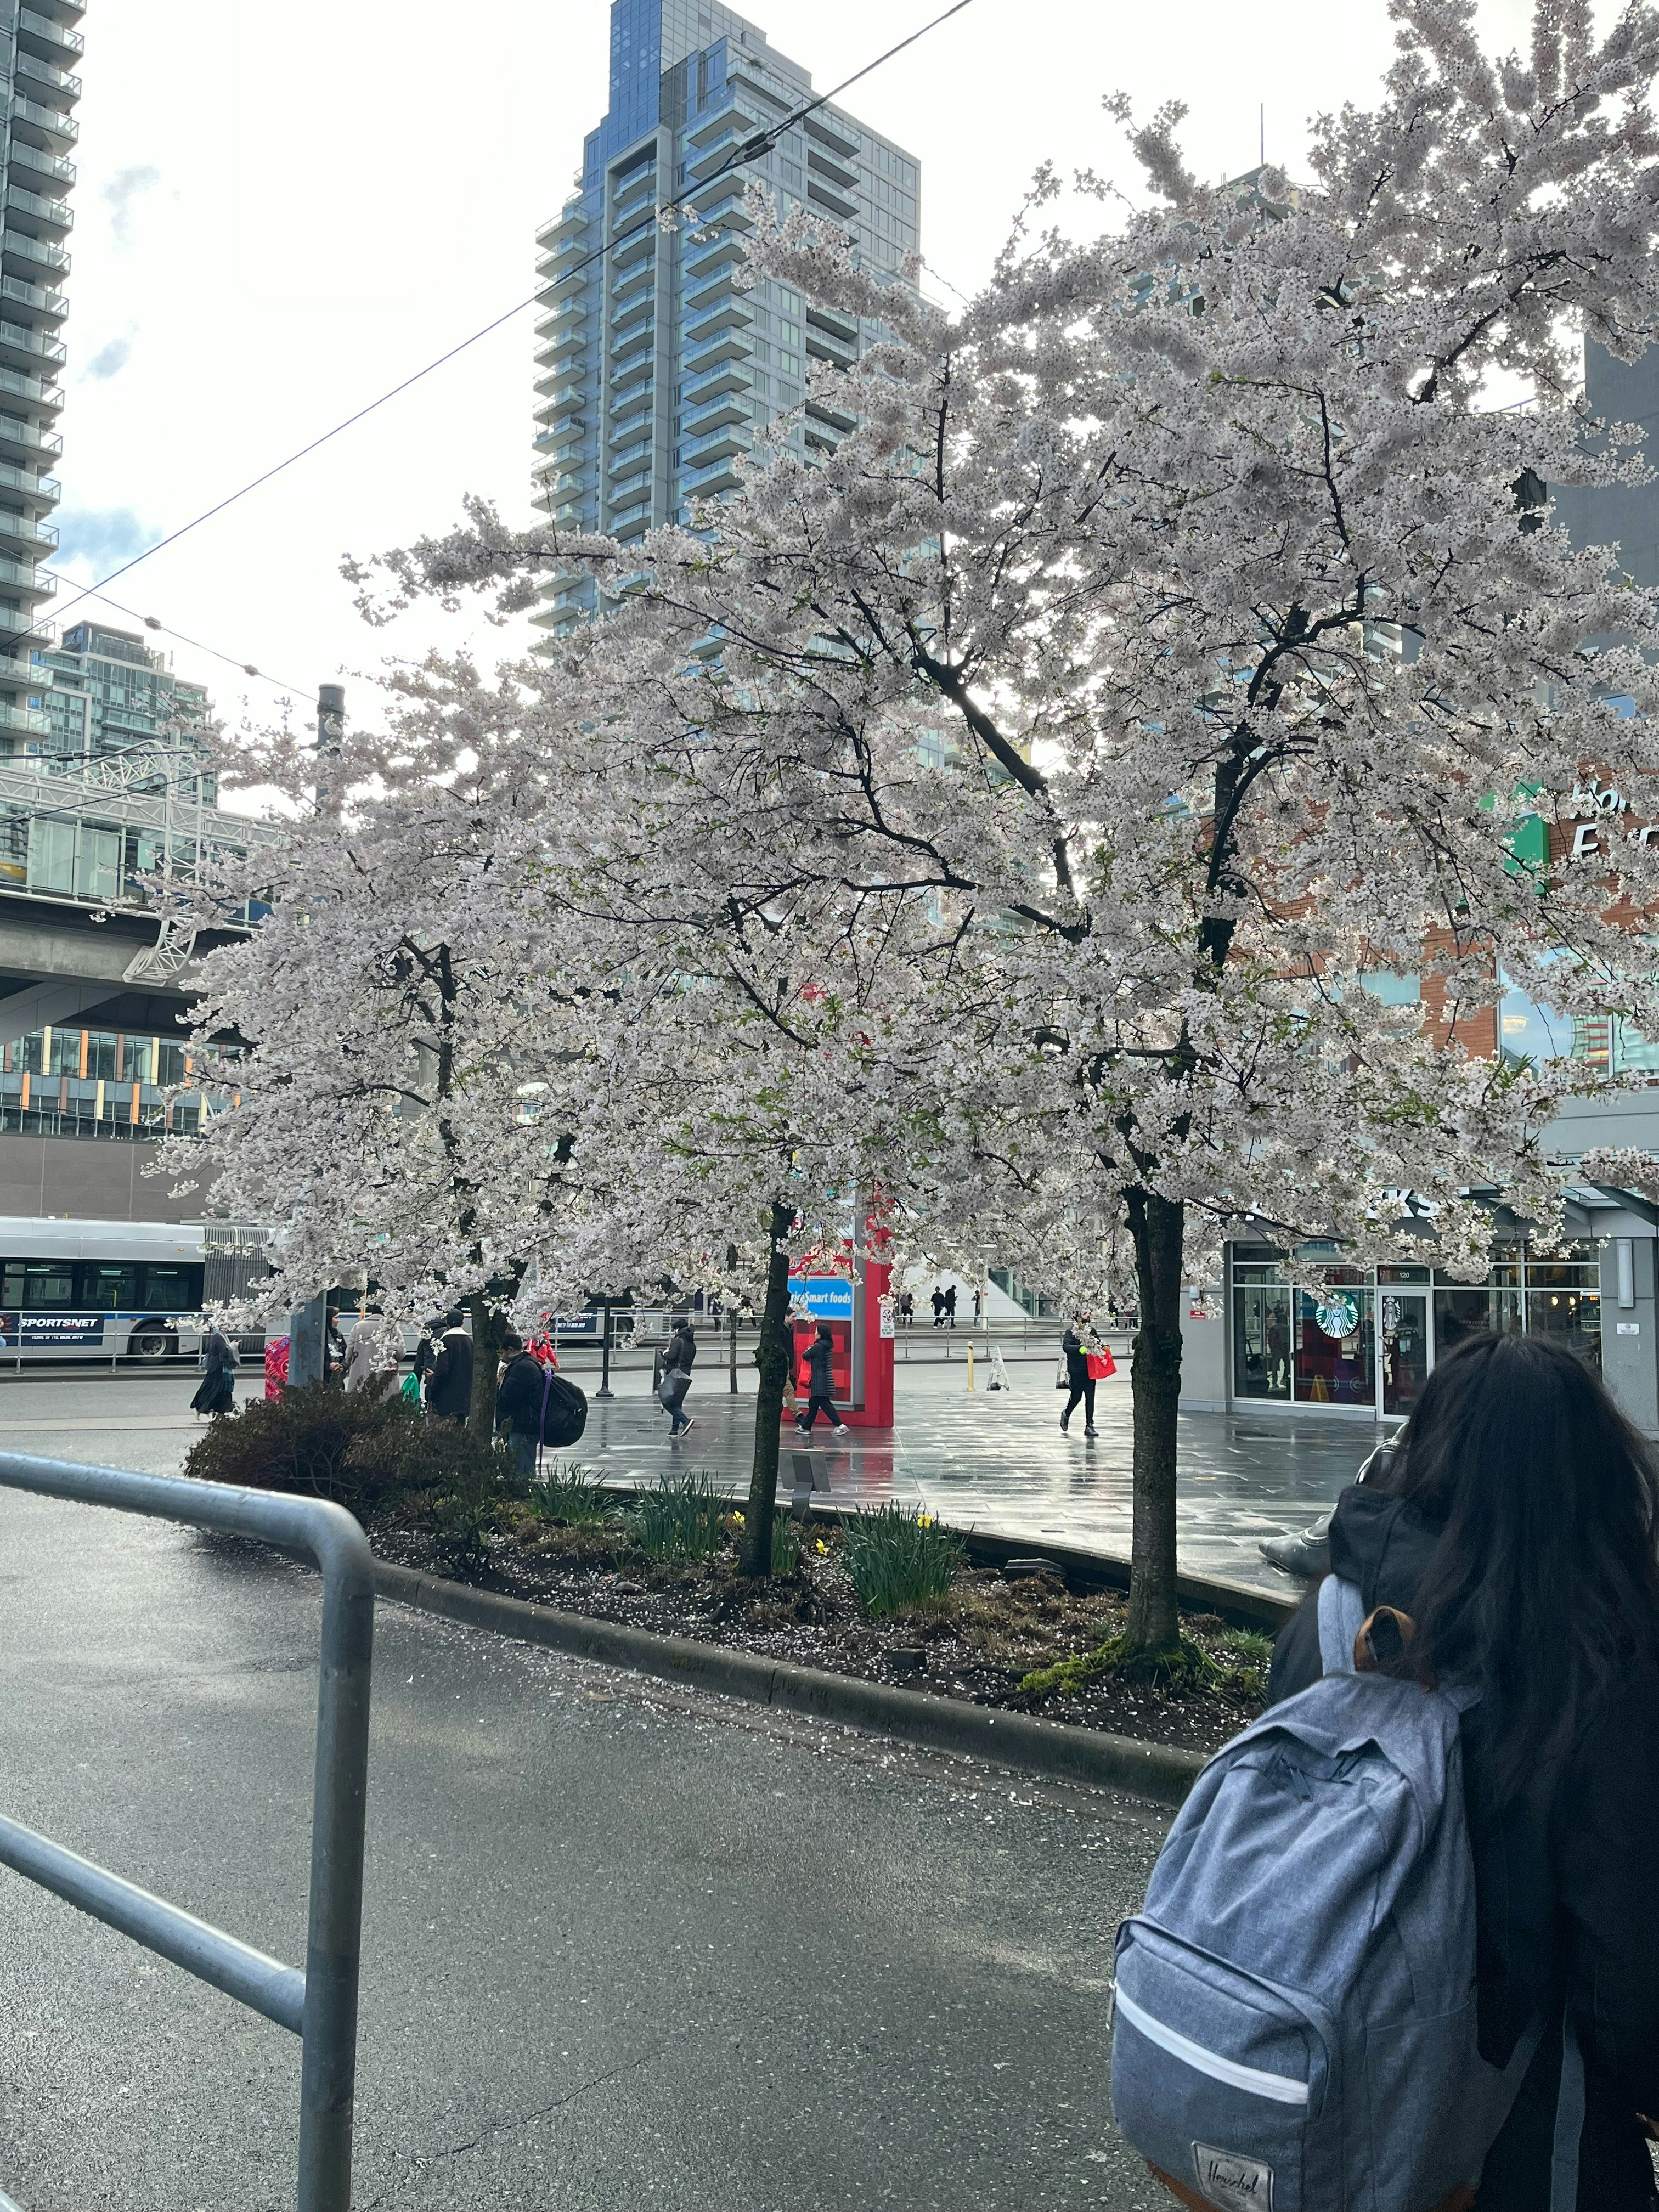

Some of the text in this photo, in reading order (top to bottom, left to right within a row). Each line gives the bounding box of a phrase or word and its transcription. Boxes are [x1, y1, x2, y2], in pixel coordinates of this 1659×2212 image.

[791, 1291, 851, 1304] riceSmart foods
[18, 1318, 98, 1327] SPORTSNET
